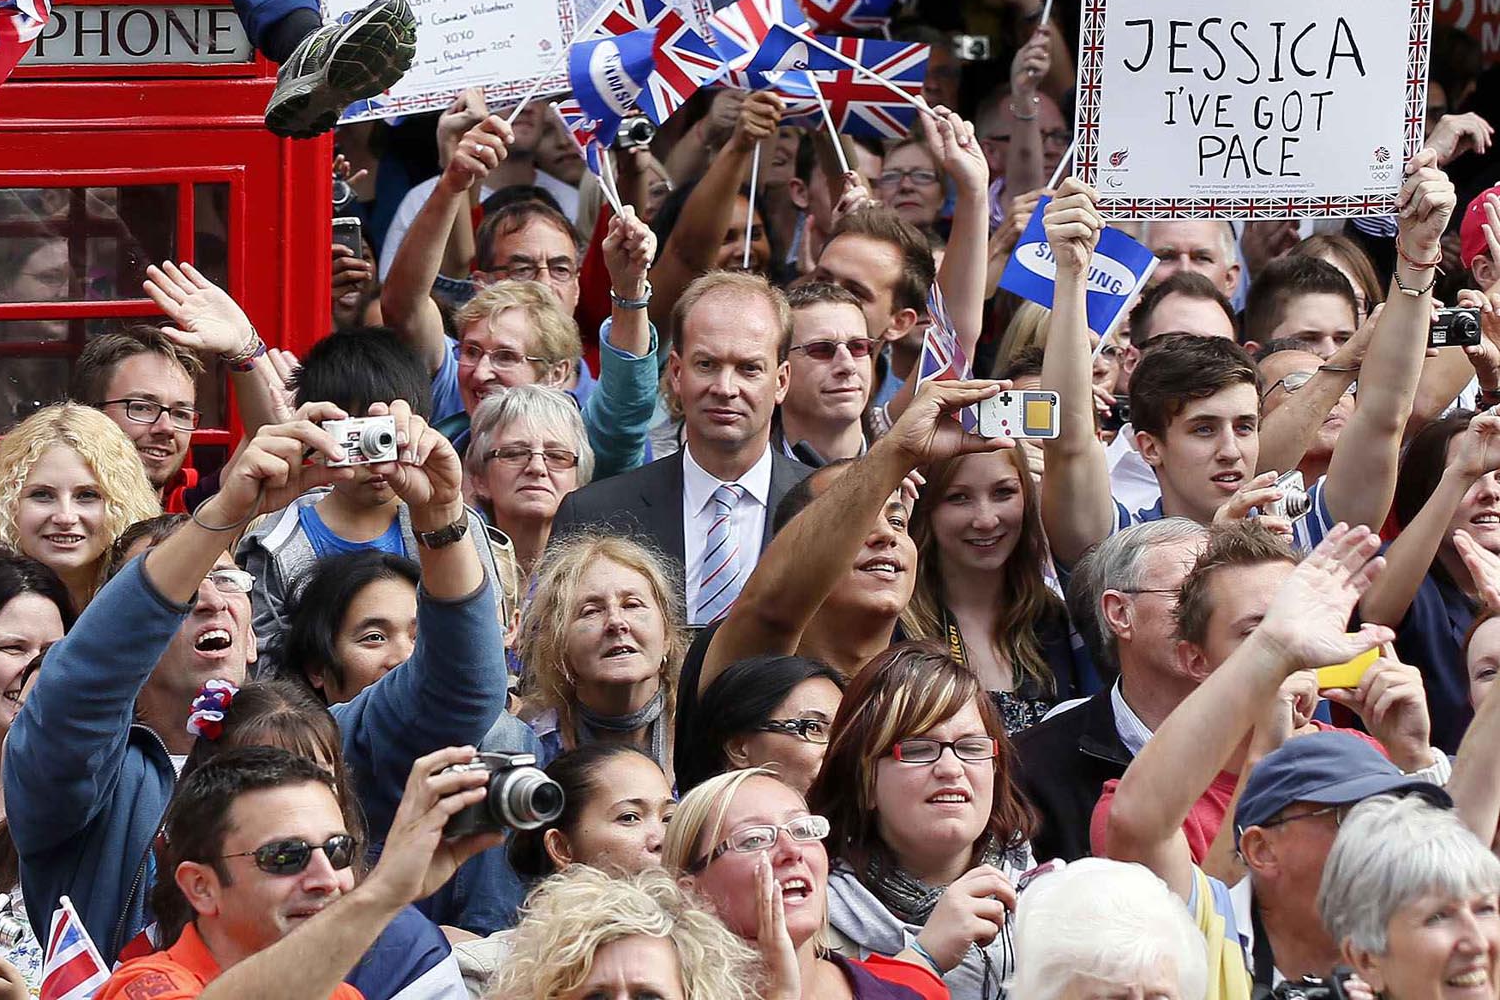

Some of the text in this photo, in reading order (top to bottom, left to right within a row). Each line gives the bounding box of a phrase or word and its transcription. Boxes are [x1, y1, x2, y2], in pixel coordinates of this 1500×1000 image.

[1122, 16, 1367, 85] JESSICA
[1164, 87, 1335, 132] I'VE GOT
[1198, 134, 1301, 179] PACE
